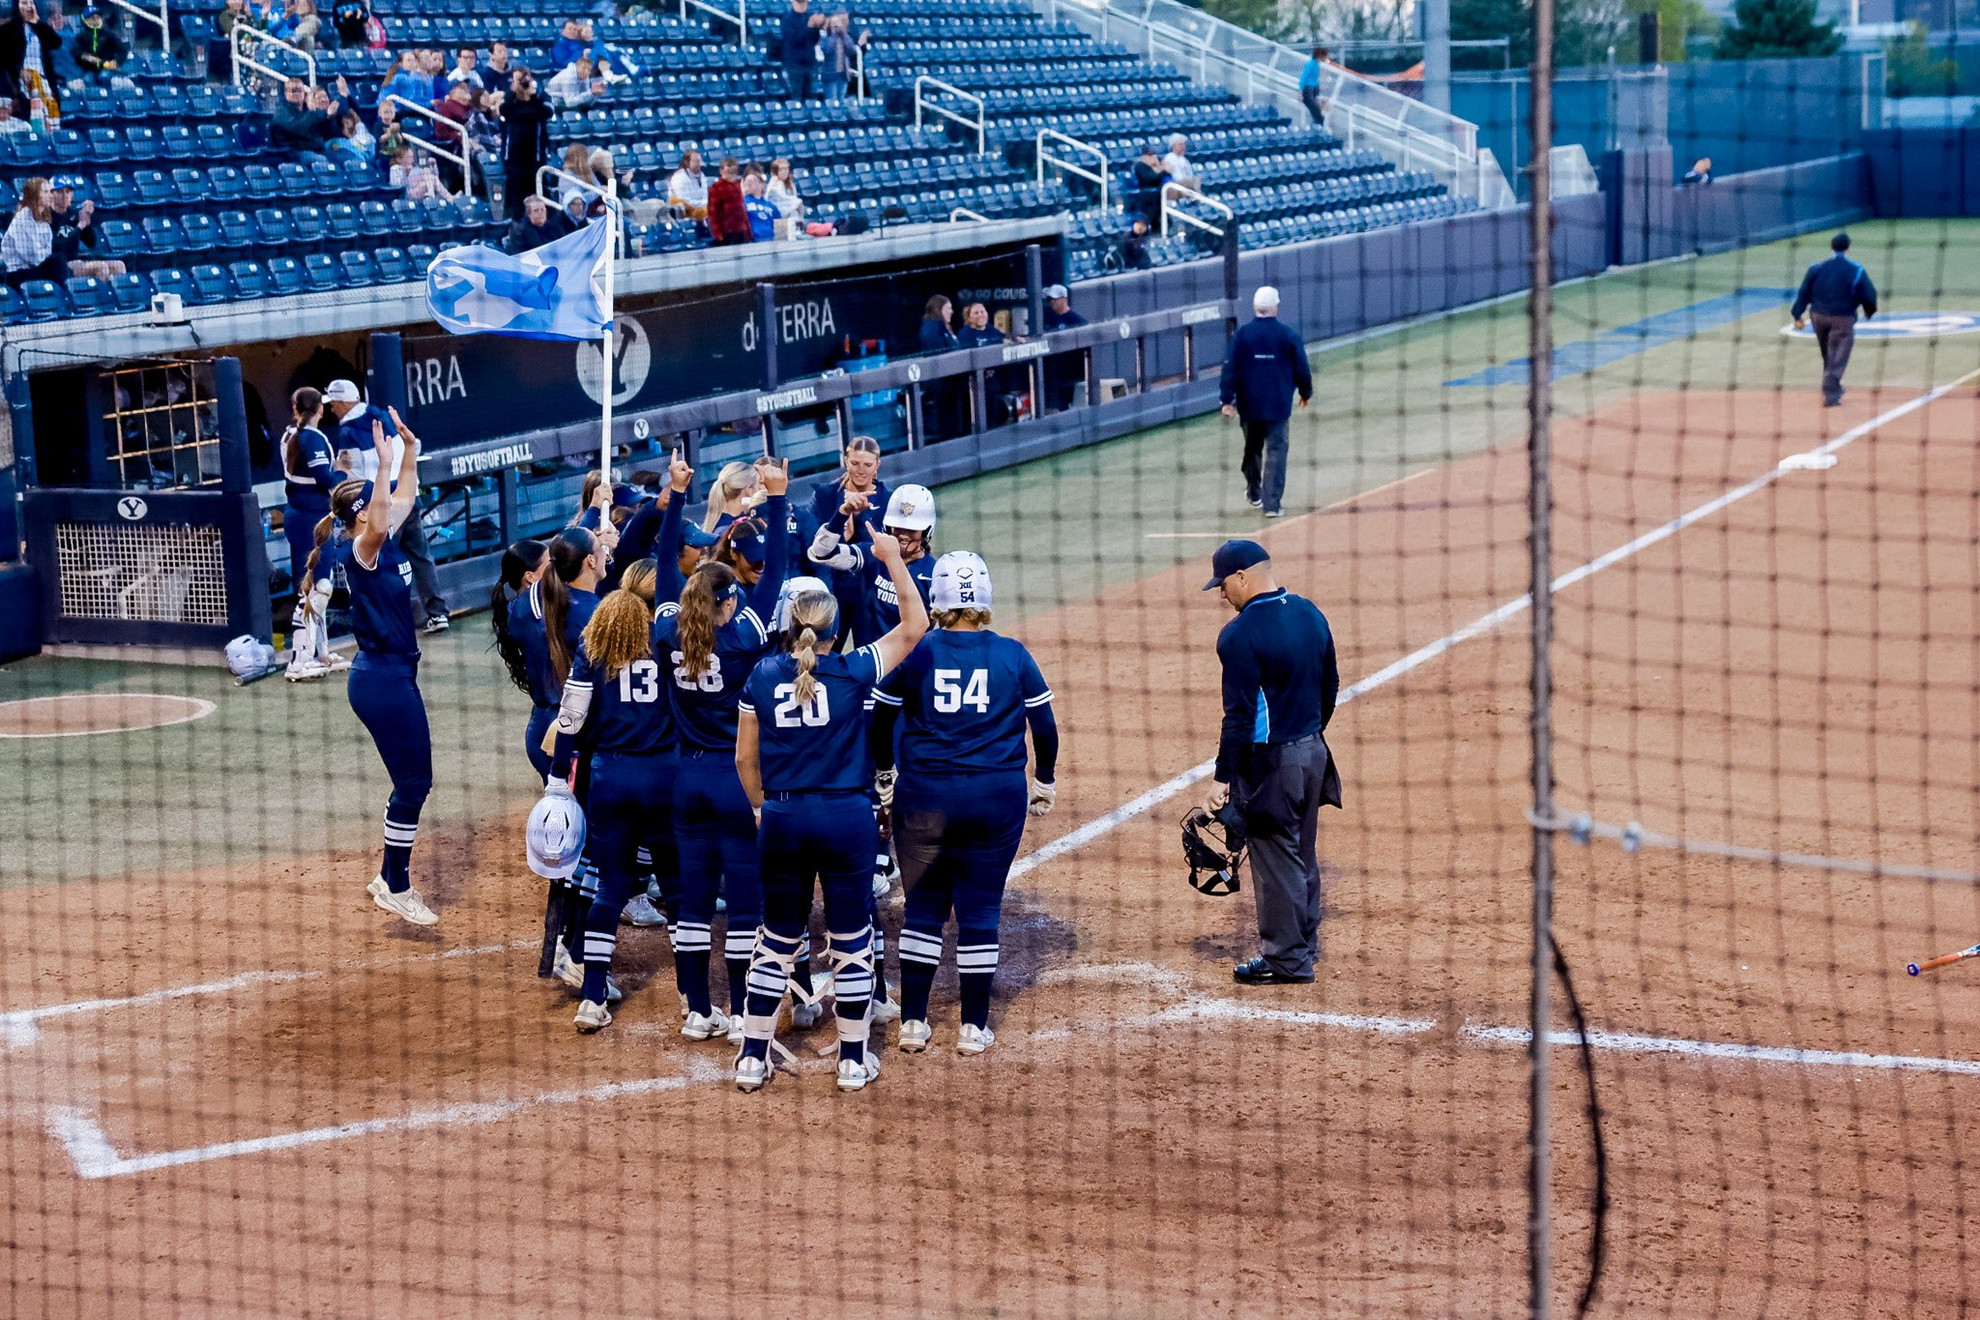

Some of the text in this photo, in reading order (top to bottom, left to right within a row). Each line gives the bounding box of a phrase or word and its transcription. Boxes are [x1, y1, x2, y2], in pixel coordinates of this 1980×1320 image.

[635, 419, 648, 438] Y
[451, 442, 533, 476] #BYUSOFTBALL
[120, 498, 144, 518] Y
[874, 574, 898, 593] BRIG
[876, 587, 899, 606] YOUN
[960, 591, 976, 604] 54
[619, 659, 658, 703] 13
[933, 668, 990, 714] 54
[774, 681, 830, 728] 20
